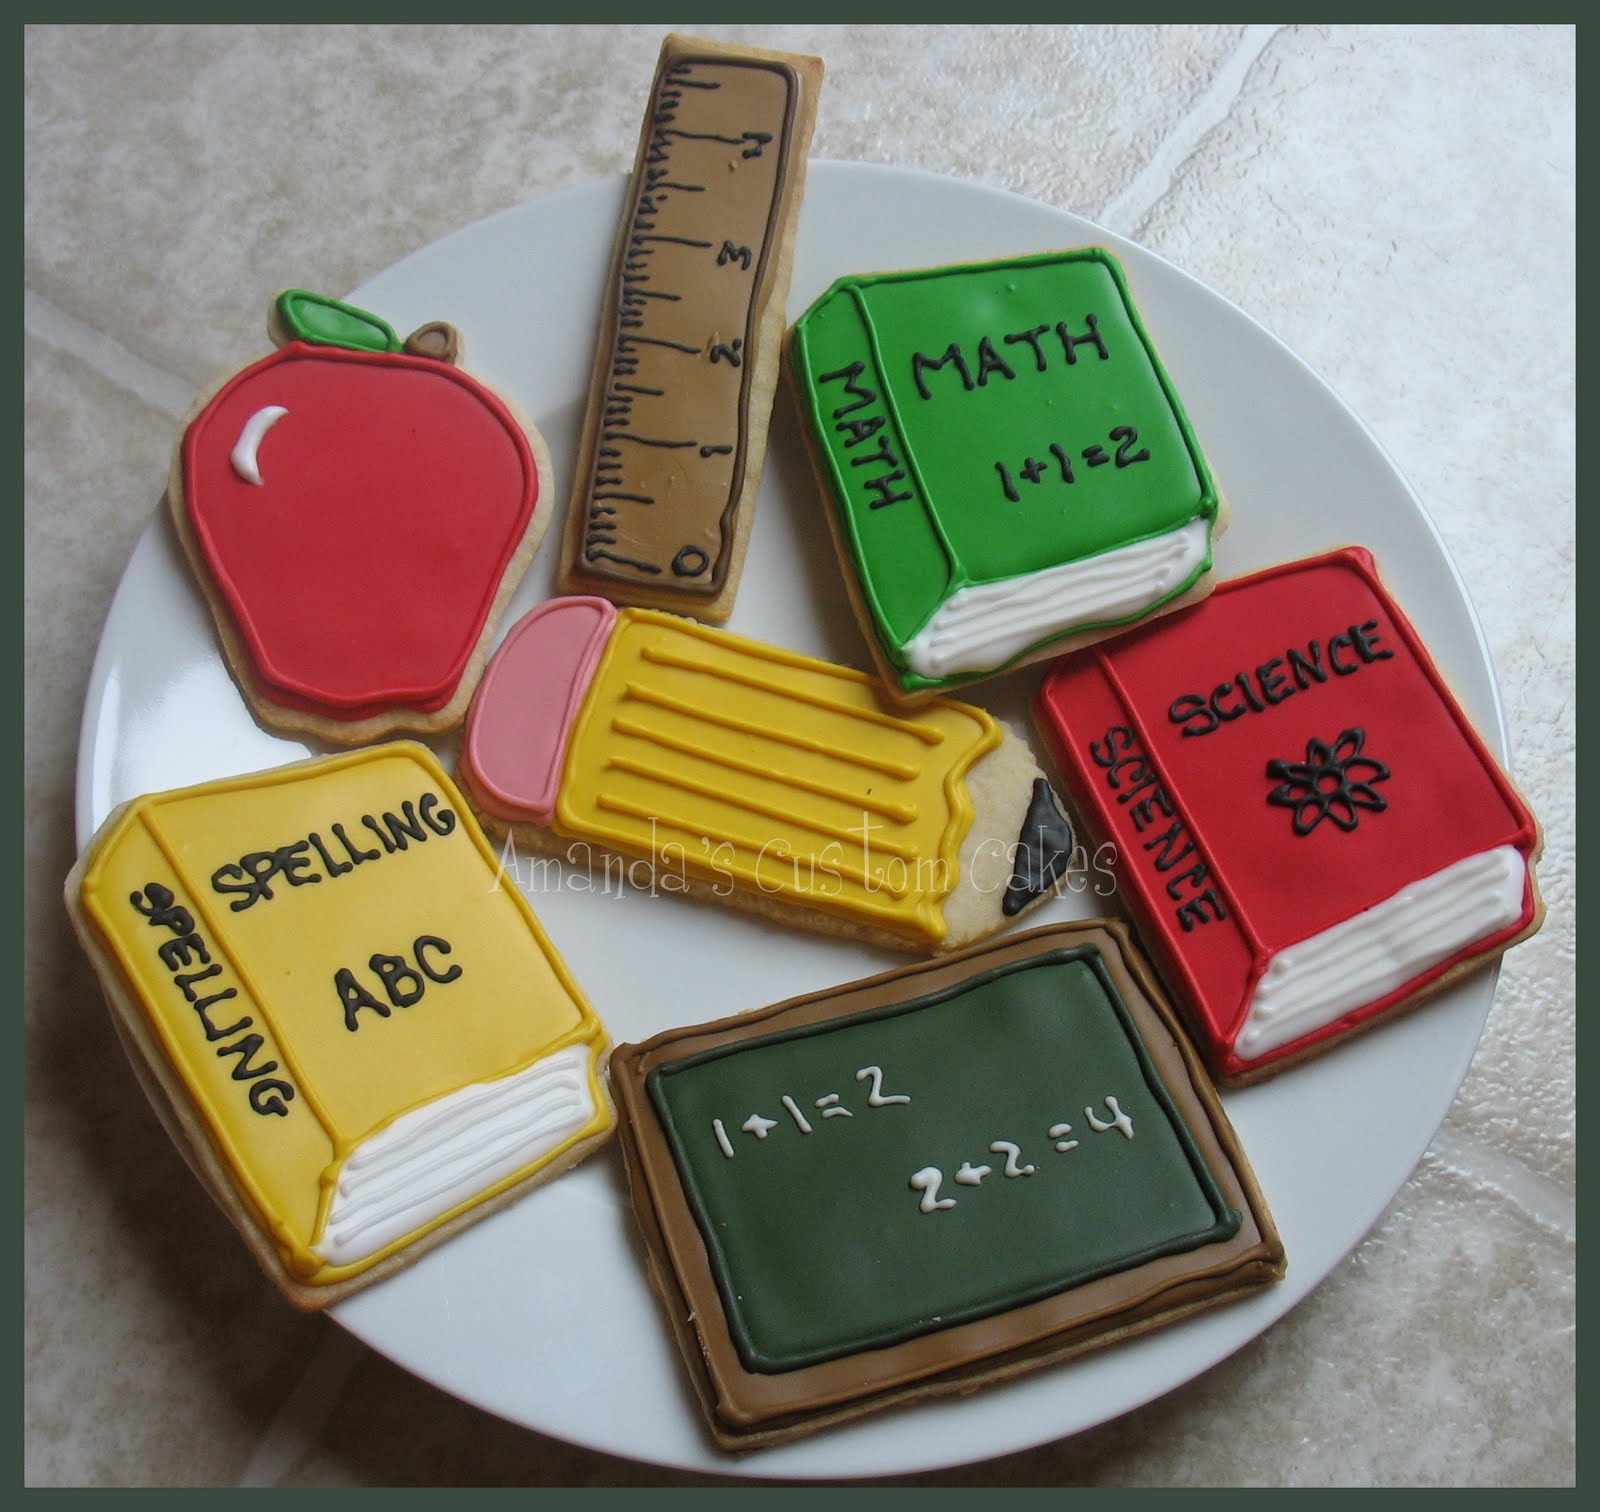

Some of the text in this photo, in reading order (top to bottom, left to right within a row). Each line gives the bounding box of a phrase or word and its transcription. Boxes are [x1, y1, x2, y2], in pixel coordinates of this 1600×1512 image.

[716, 238, 753, 272] 3
[710, 336, 743, 368] 2
[911, 312, 1110, 400] MATH
[818, 360, 914, 511] MATH
[1167, 618, 1395, 738] SCIENCE
[210, 791, 457, 913] SPELLING
[1089, 723, 1227, 932] SCIENCE
[129, 881, 296, 1118] SPELLING
[333, 934, 464, 1032] ABC
